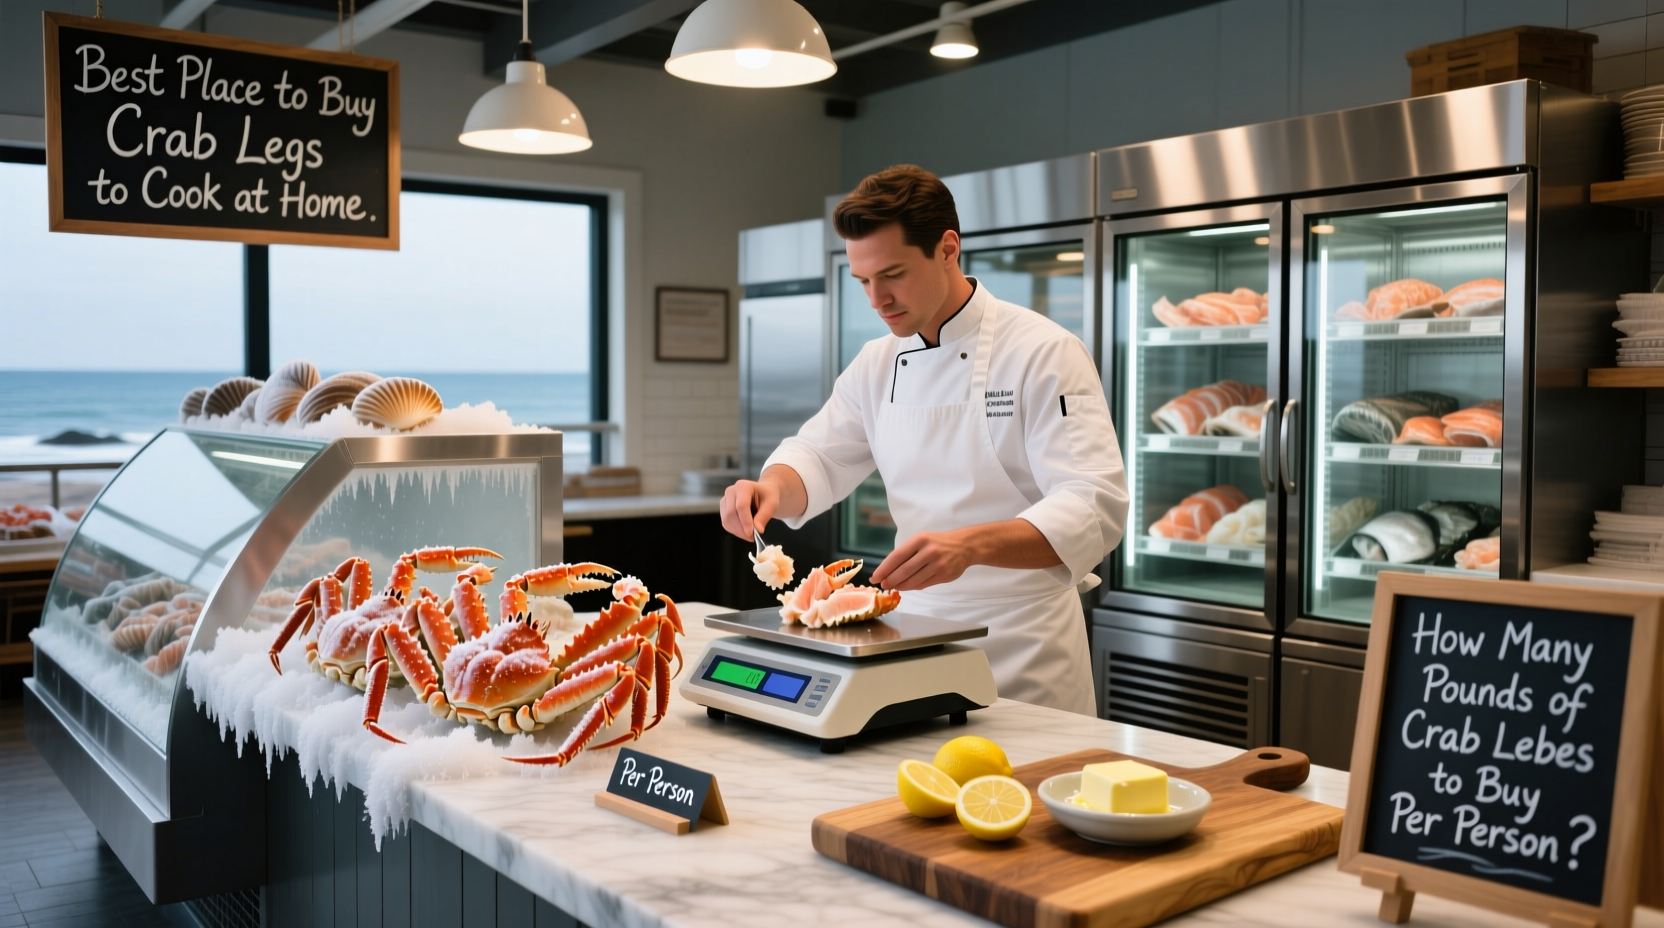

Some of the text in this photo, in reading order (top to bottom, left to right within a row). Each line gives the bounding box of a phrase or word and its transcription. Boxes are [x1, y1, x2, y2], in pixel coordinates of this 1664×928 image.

[73, 44, 376, 137] Best Place to Buy
[106, 102, 324, 182] Crab Legs
[87, 165, 377, 222] to Cook at Home.
[1411, 612, 1594, 684] How Many
[1422, 663, 1594, 734] Pounds of
[1401, 708, 1594, 774] Crab Lebes
[619, 756, 695, 807] Per Person
[1389, 791, 1443, 836] Per
[1428, 761, 1541, 824] to Buy
